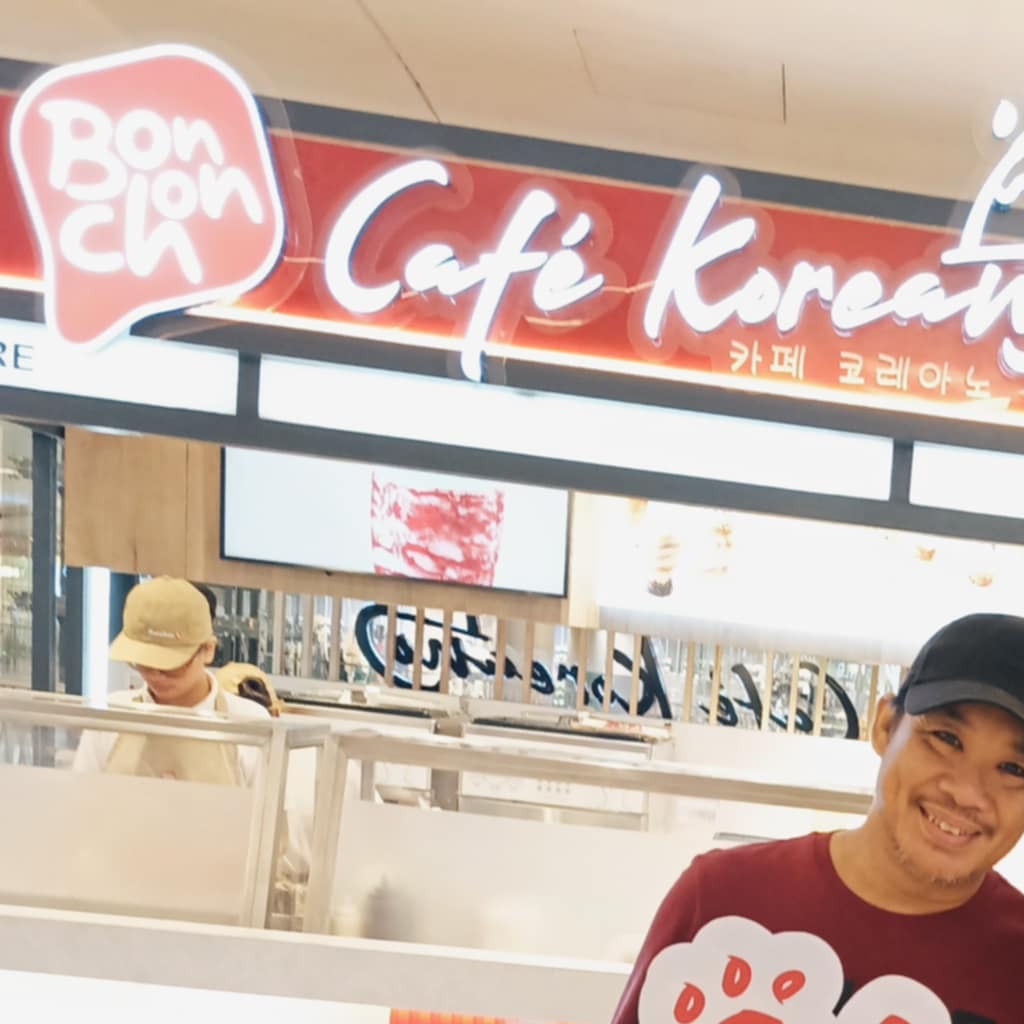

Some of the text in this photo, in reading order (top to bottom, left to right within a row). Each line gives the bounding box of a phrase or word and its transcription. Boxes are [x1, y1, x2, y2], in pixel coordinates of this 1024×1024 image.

[38, 98, 223, 202] Bon
[325, 159, 605, 384] Café
[728, 339, 992, 400] 카페 코레아노
